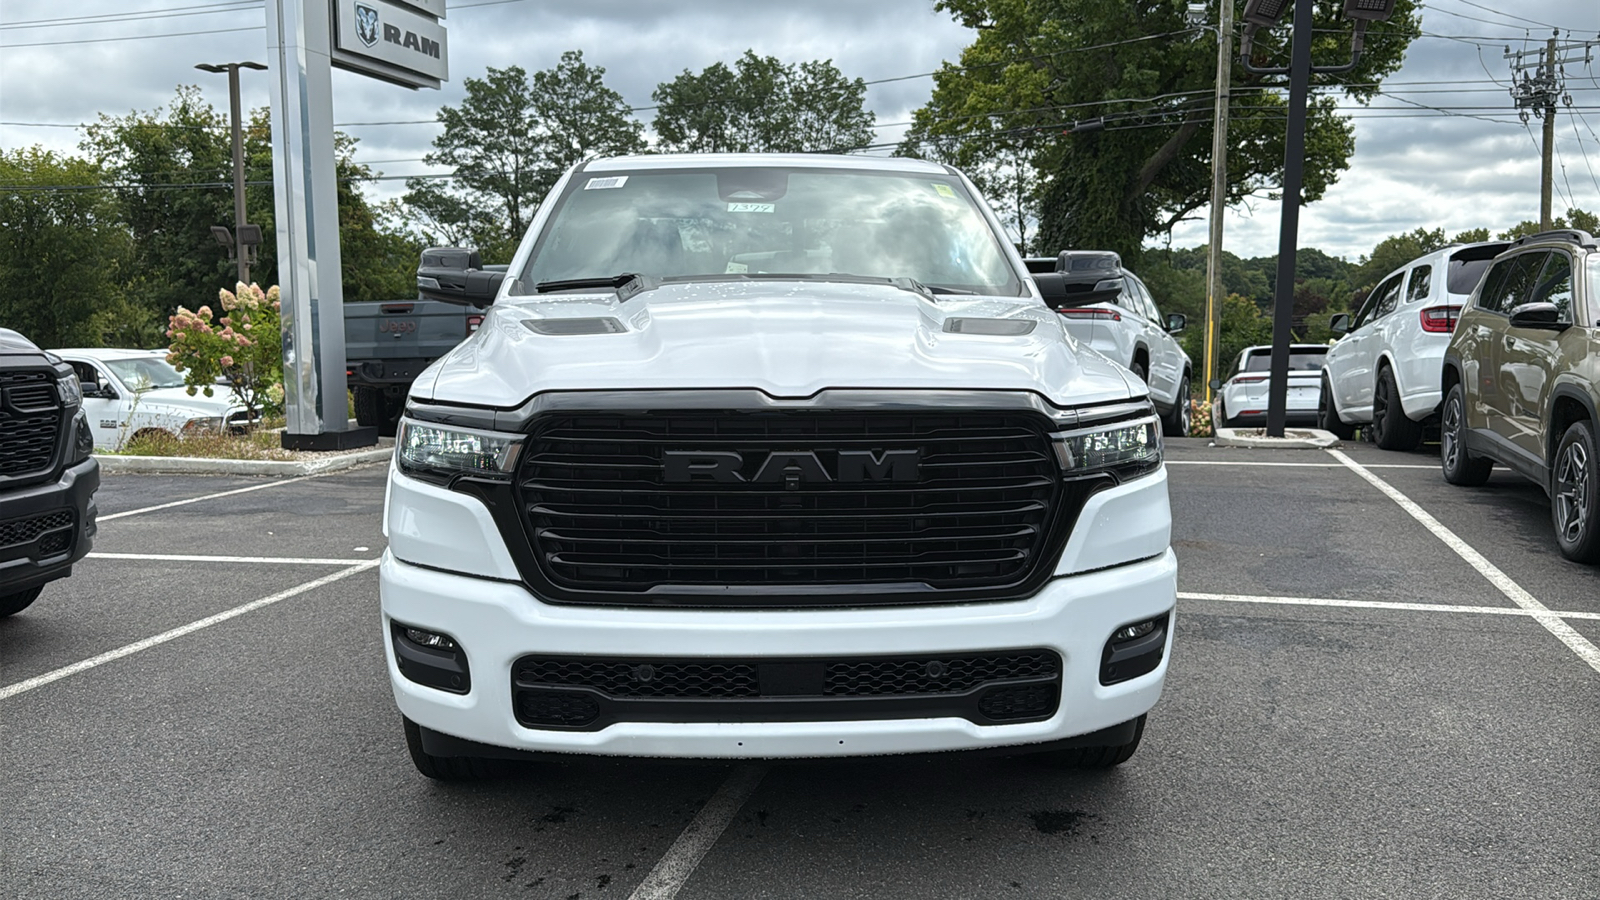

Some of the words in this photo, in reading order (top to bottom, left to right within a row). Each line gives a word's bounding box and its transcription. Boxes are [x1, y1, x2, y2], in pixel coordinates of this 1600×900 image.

[383, 22, 441, 60] RAM
[379, 319, 417, 335] Jeep
[663, 449, 920, 483] RAM
